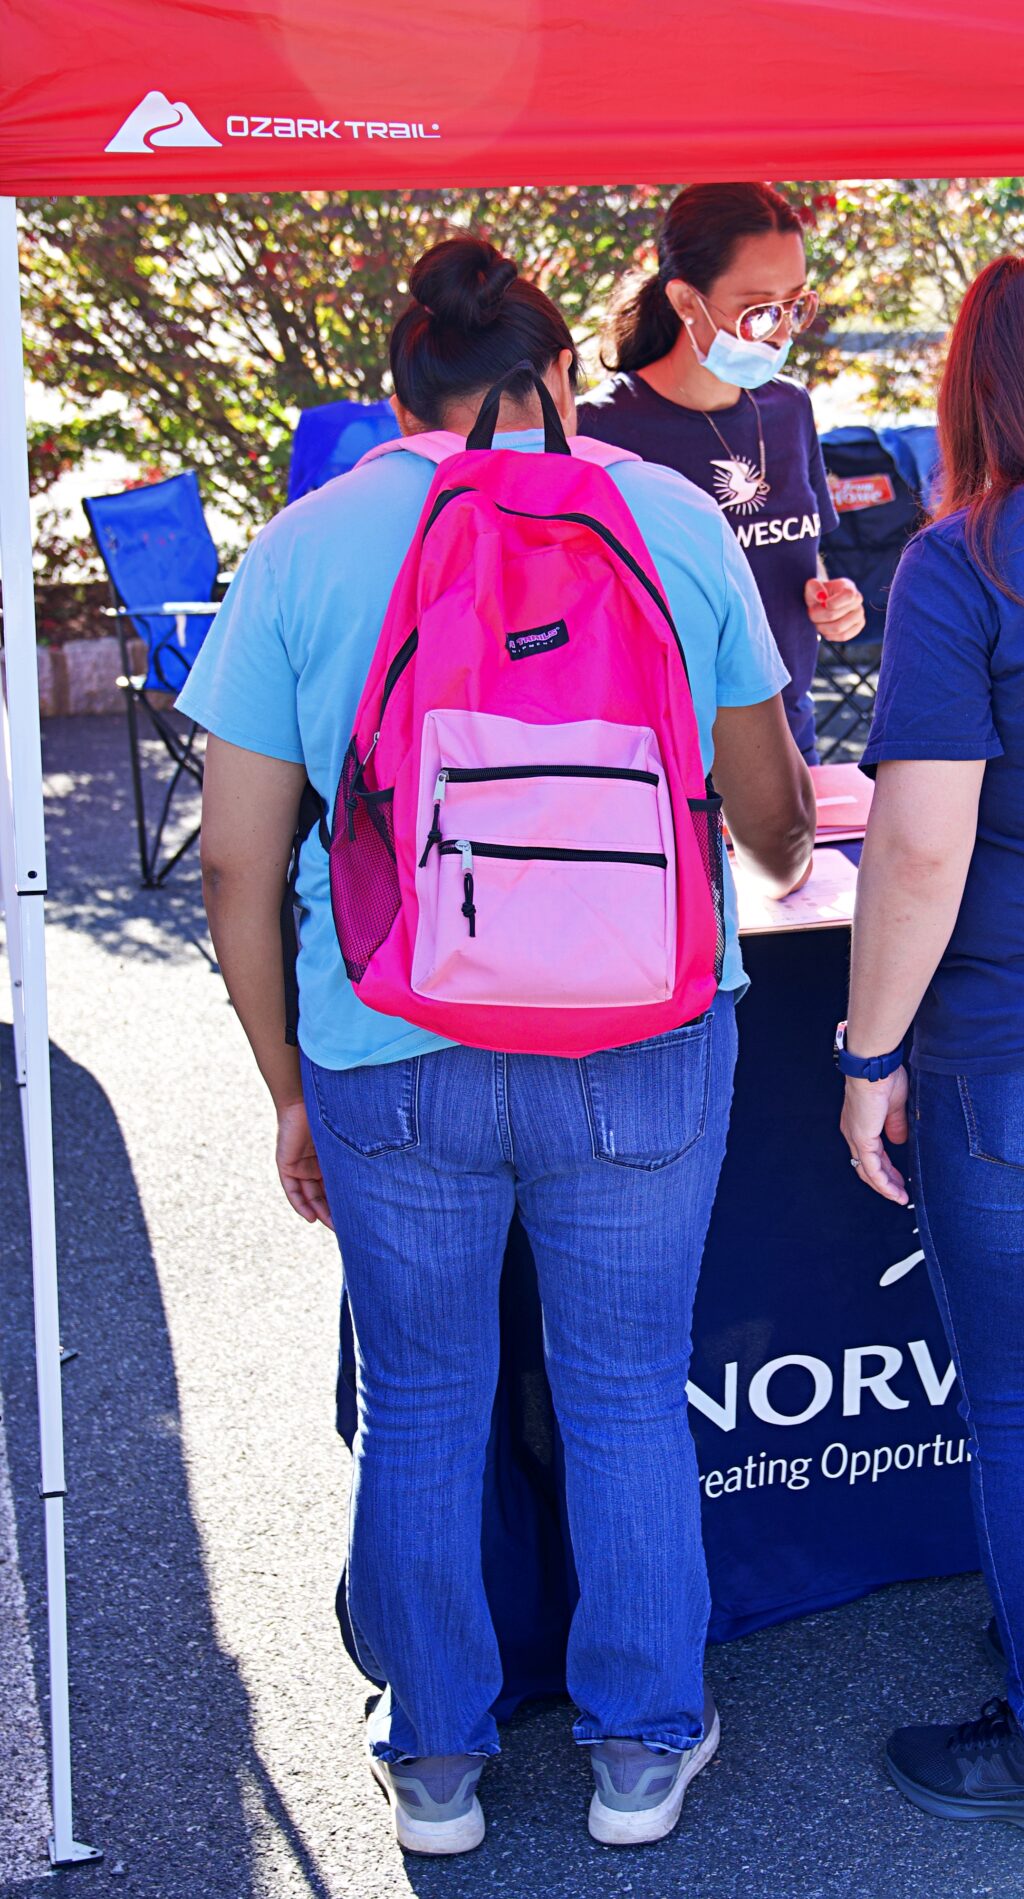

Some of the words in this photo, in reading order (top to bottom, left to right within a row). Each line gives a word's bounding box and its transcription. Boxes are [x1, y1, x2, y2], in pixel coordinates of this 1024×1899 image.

[226, 115, 342, 138] OZARK
[736, 513, 821, 548] WESCA
[699, 1452, 812, 1498] eating
[821, 1434, 972, 1485] Opportu
